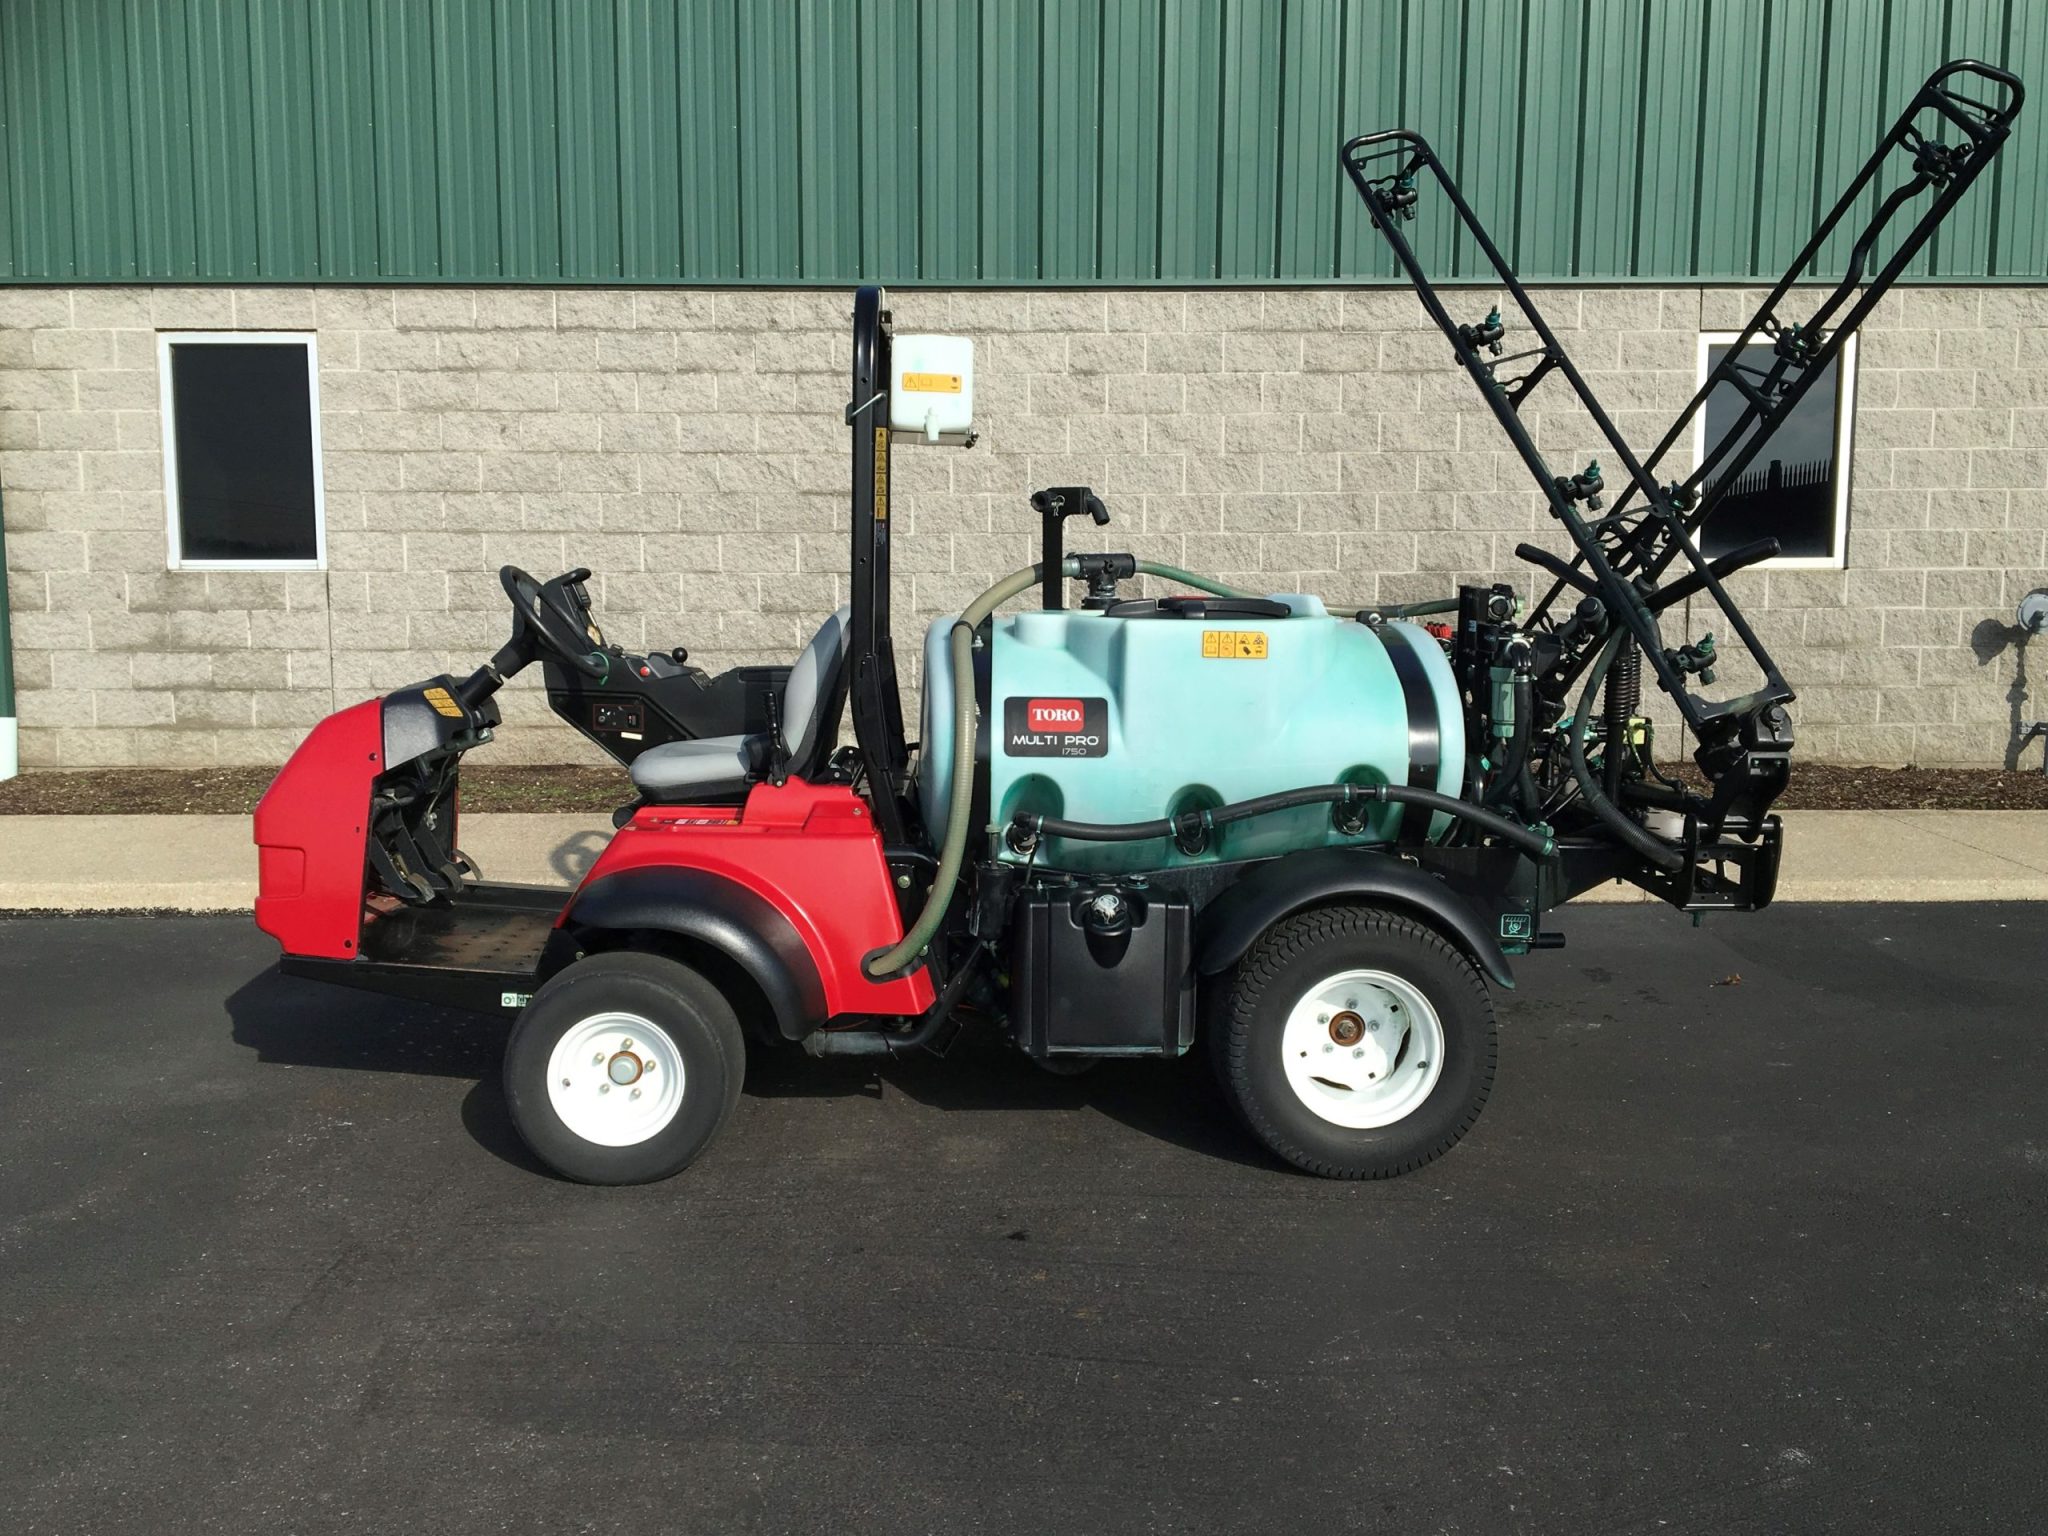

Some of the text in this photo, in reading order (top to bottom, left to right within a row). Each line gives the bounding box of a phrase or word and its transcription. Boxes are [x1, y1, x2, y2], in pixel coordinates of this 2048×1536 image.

[1032, 708, 1080, 722] TORO
[1012, 735, 1099, 746] MULTI PRO
[1062, 747, 1087, 756] 1750
